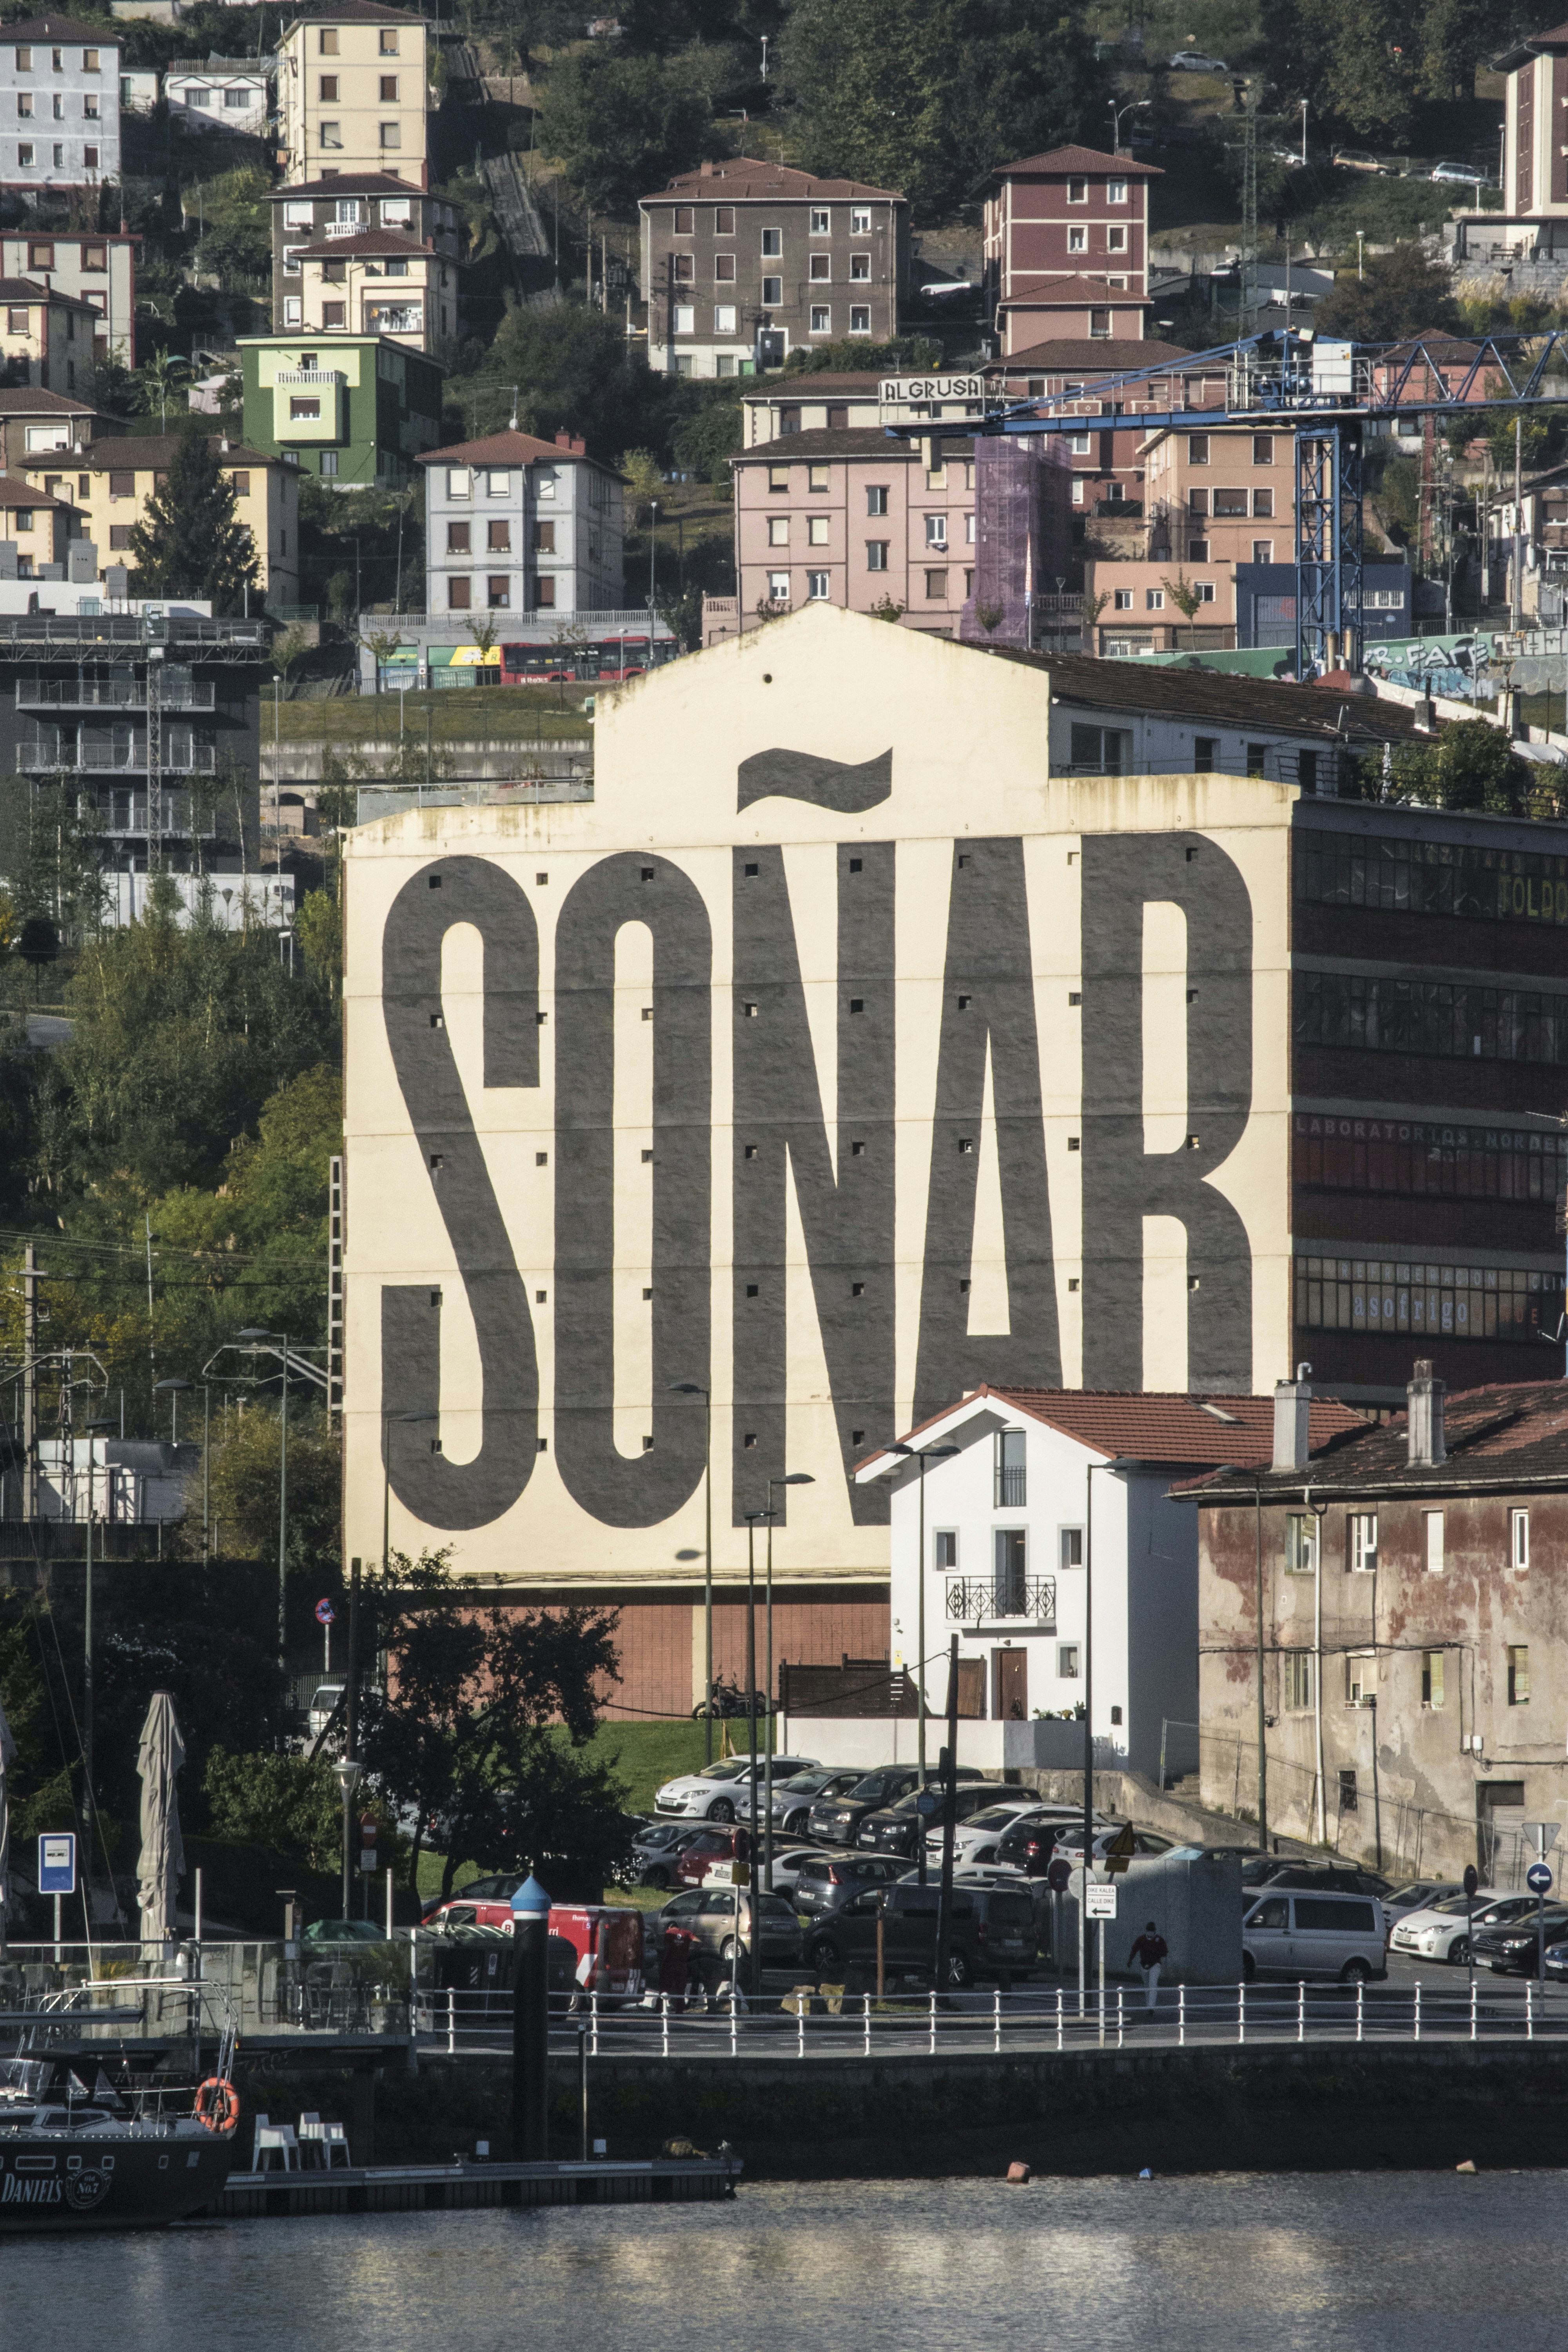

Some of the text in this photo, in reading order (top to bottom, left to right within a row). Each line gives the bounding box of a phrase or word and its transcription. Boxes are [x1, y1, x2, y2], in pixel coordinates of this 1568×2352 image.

[885, 378, 978, 401] ALGRUSA
[381, 747, 1253, 1531] SOÑAR
[1354, 1292, 1468, 1330] asofrigo
[0, 2173, 63, 2203] DANIEL'S
